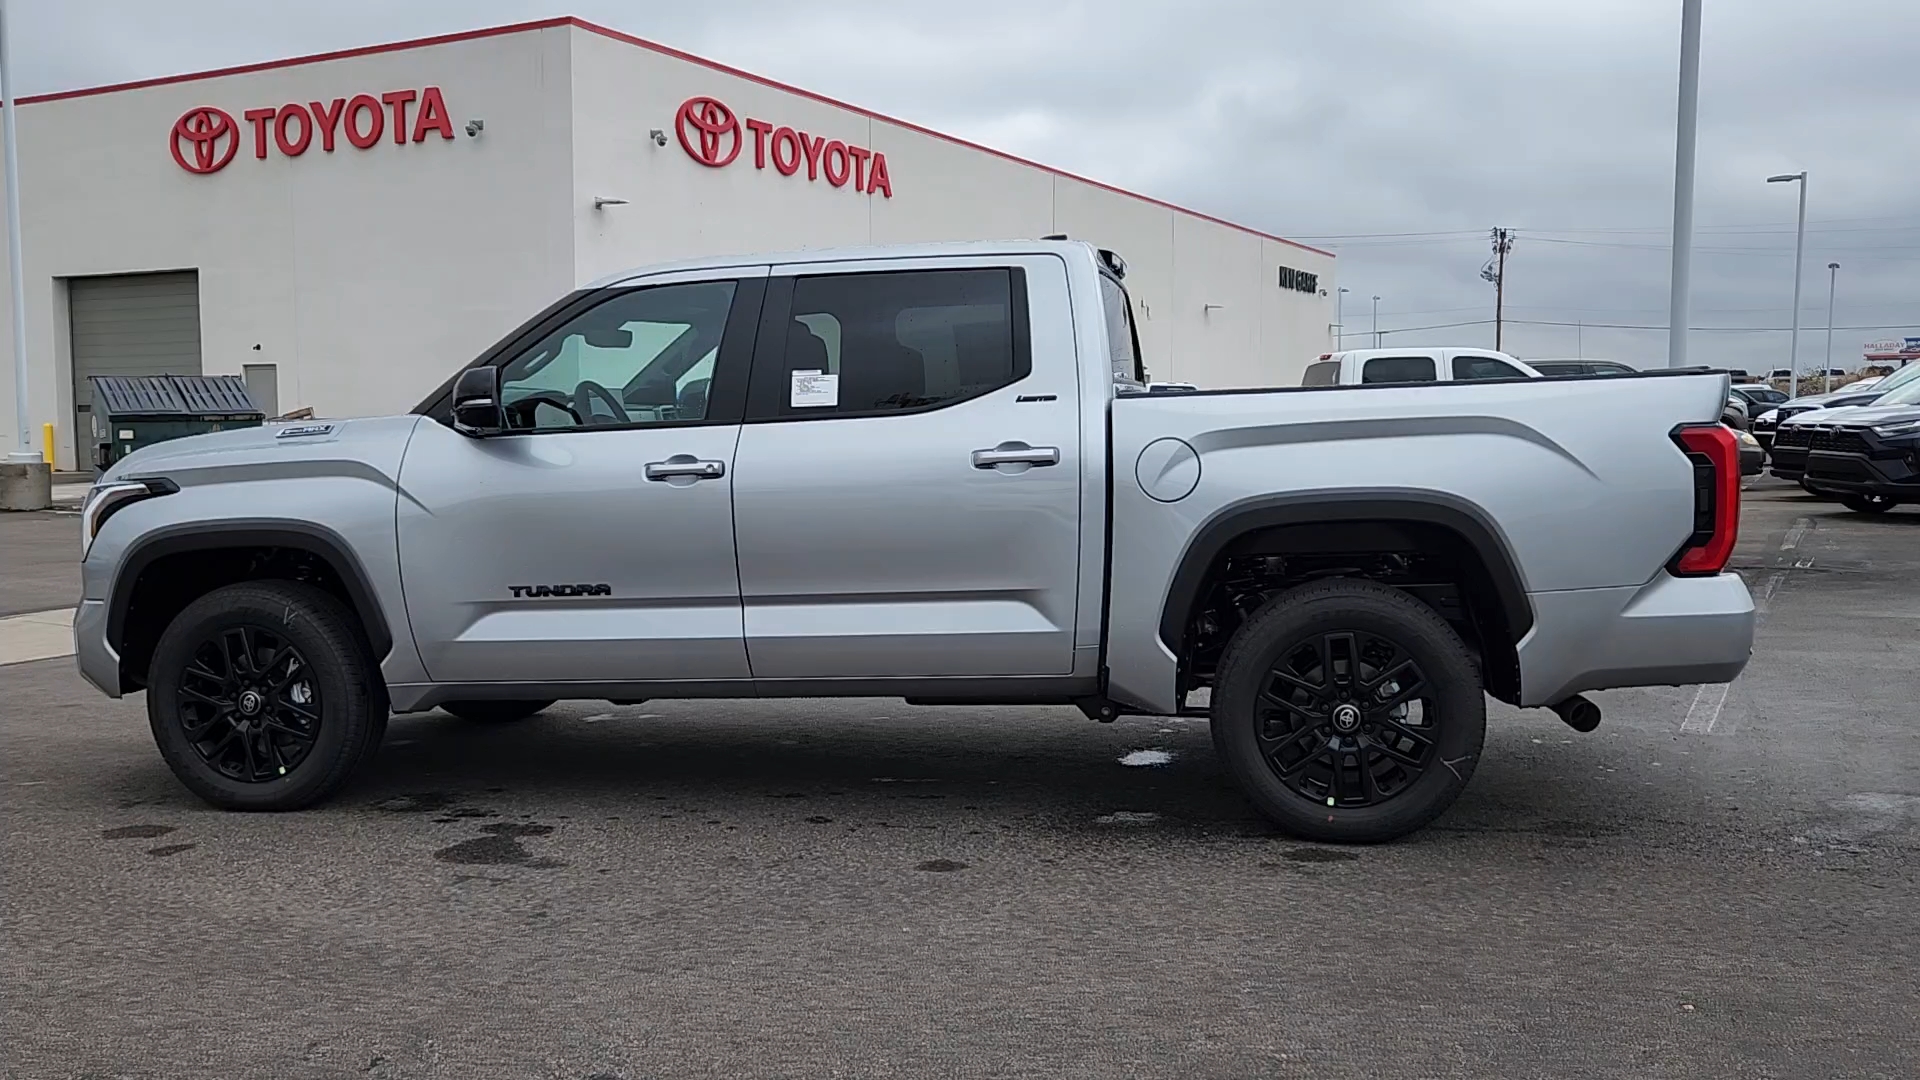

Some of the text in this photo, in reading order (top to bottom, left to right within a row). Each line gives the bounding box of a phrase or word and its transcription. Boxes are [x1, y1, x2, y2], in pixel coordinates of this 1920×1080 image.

[244, 86, 455, 159] TOYOTA
[746, 117, 893, 198] TOYOTA
[508, 583, 612, 598] TUNDRA
